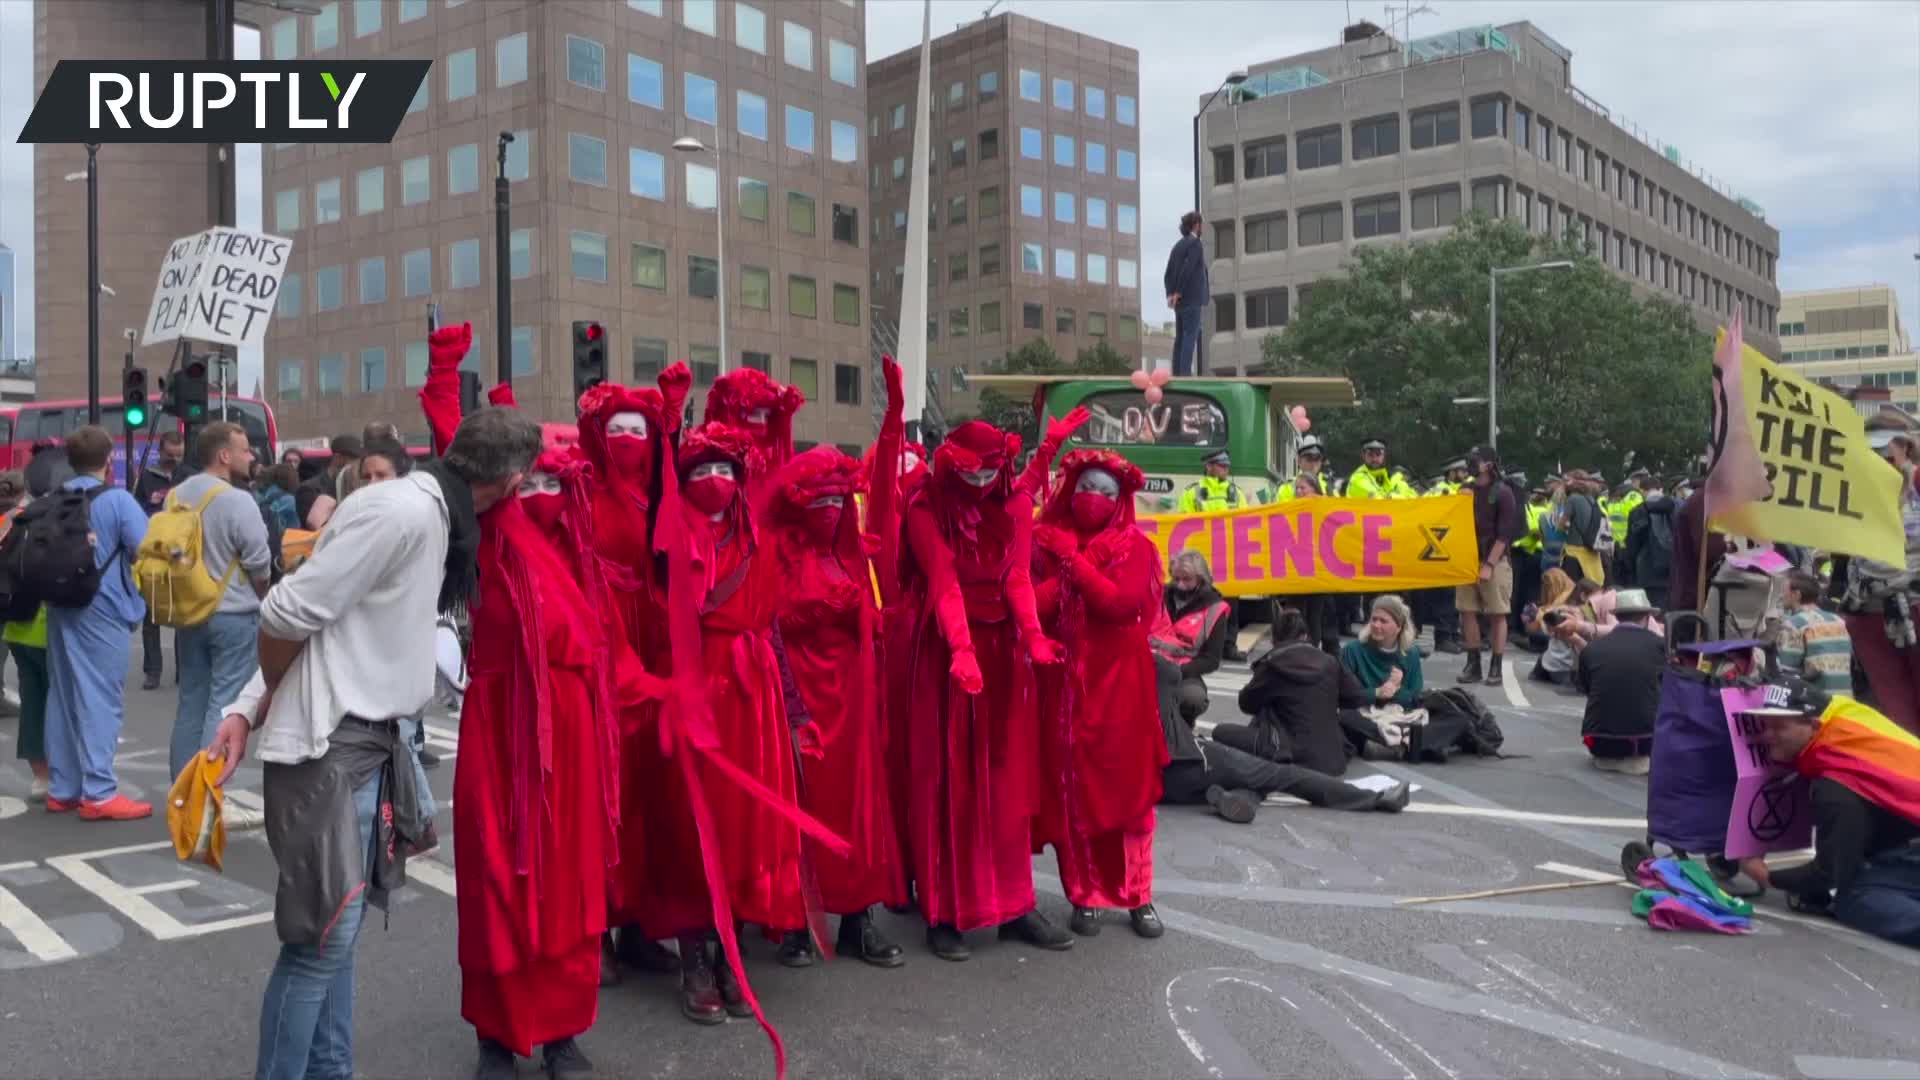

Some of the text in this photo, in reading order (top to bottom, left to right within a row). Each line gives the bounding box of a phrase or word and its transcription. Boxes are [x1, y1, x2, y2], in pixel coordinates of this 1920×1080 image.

[171, 232, 287, 266] NO PATIENTS
[163, 265, 187, 288] ON
[211, 264, 278, 299] DEAD
[152, 291, 267, 341] PLANET
[1756, 411, 1846, 471] THE
[1136, 511, 1393, 583] CIENCE
